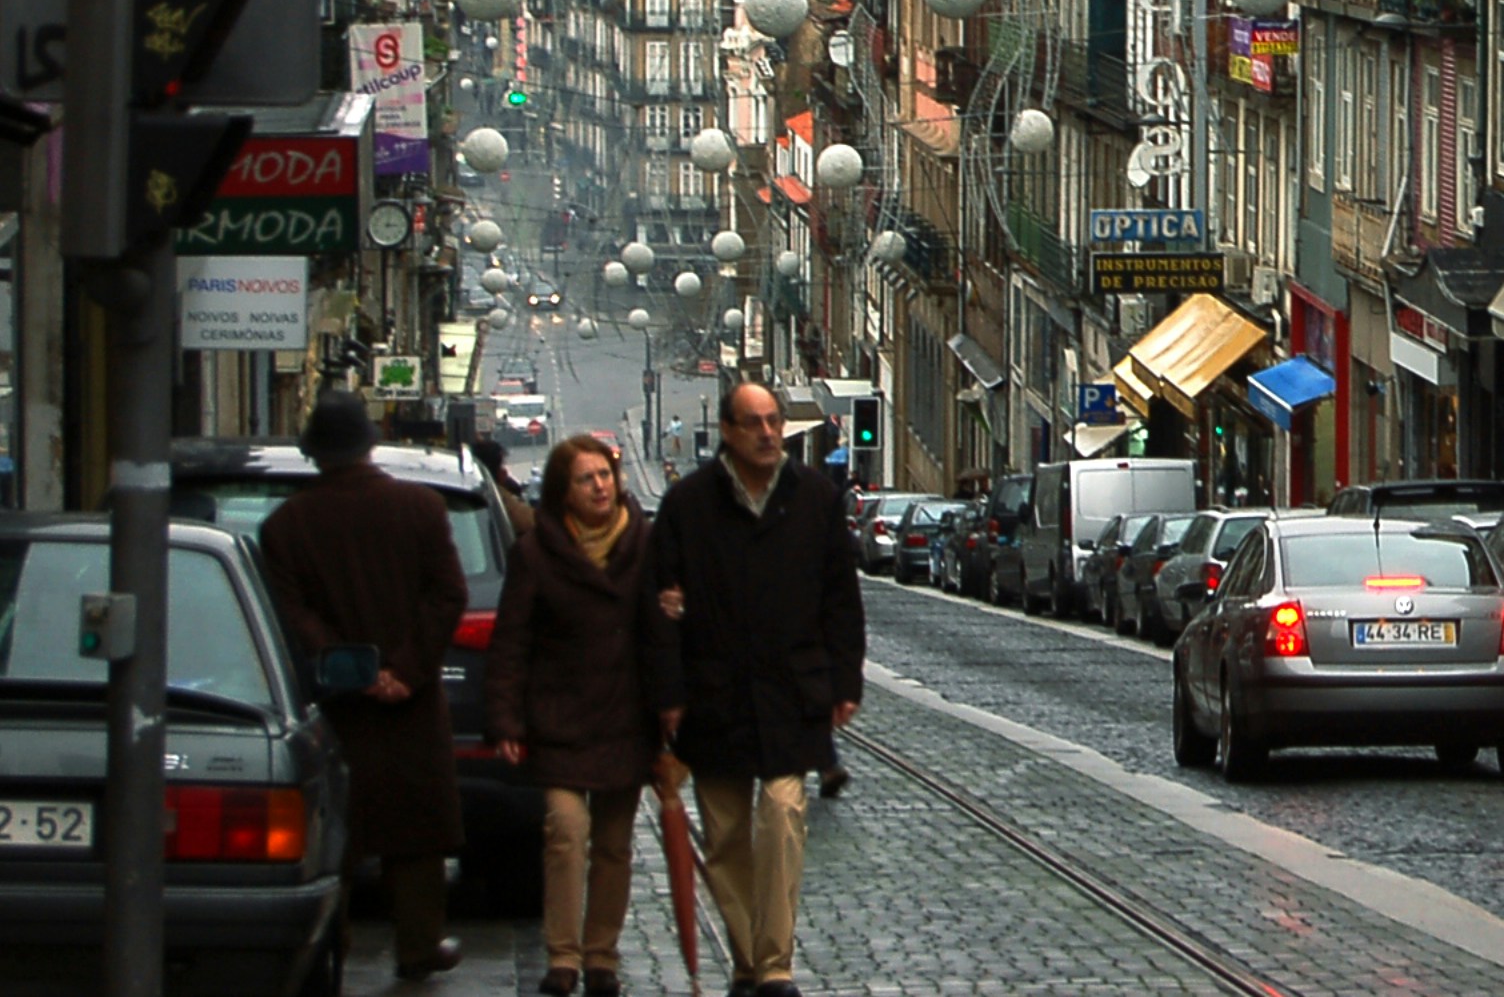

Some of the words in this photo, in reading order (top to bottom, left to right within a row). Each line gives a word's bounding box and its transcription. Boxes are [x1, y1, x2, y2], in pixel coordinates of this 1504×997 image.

[1096, 259, 1223, 272] INSTRUMENTOS
[1101, 276, 1123, 289] DE
[188, 310, 239, 323] NOIVOS
[250, 312, 300, 324] NOIVAS
[1084, 387, 1101, 409] P
